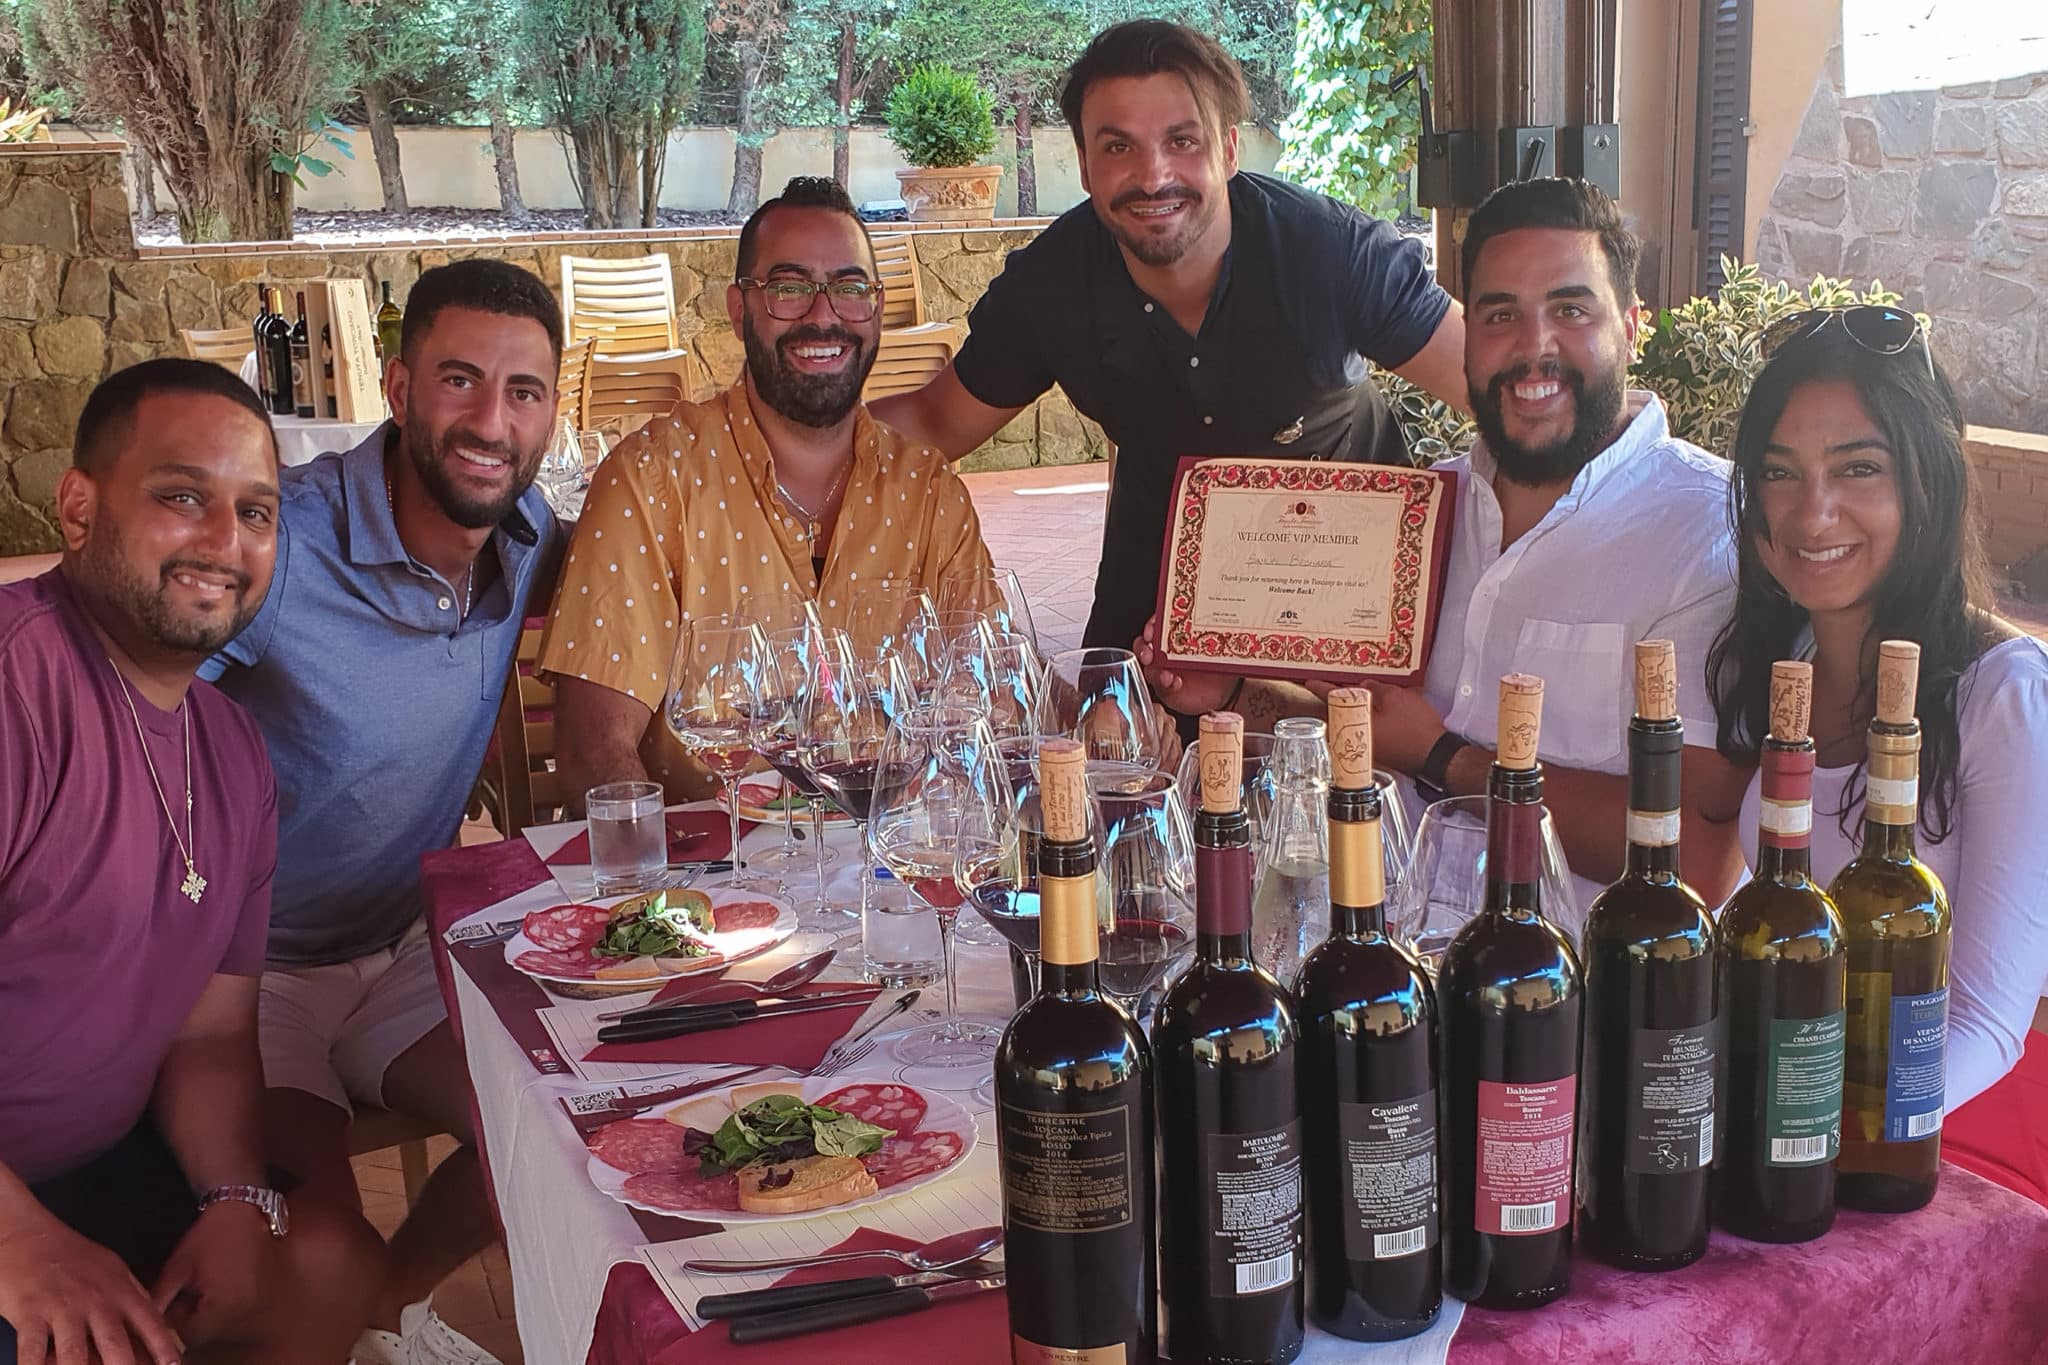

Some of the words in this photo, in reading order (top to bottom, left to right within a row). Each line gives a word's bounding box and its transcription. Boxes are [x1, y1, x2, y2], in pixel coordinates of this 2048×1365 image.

[1238, 532, 1290, 543] WELCOME
[1293, 533, 1310, 543] VIP
[1312, 534, 1359, 545] MEMBER
[1268, 585, 1295, 594] Welcome
[1297, 587, 1315, 595] Back!
[1371, 1103, 1419, 1117] Cavaliere
[1026, 1115, 1086, 1125] TERRESTRE
[1033, 1125, 1078, 1135] TOSCANA
[1045, 1132, 1088, 1142] Geografica
[1090, 1131, 1112, 1141] Tipica
[1041, 1141, 1072, 1150] ROSSO
[1045, 1150, 1067, 1158] 2014
